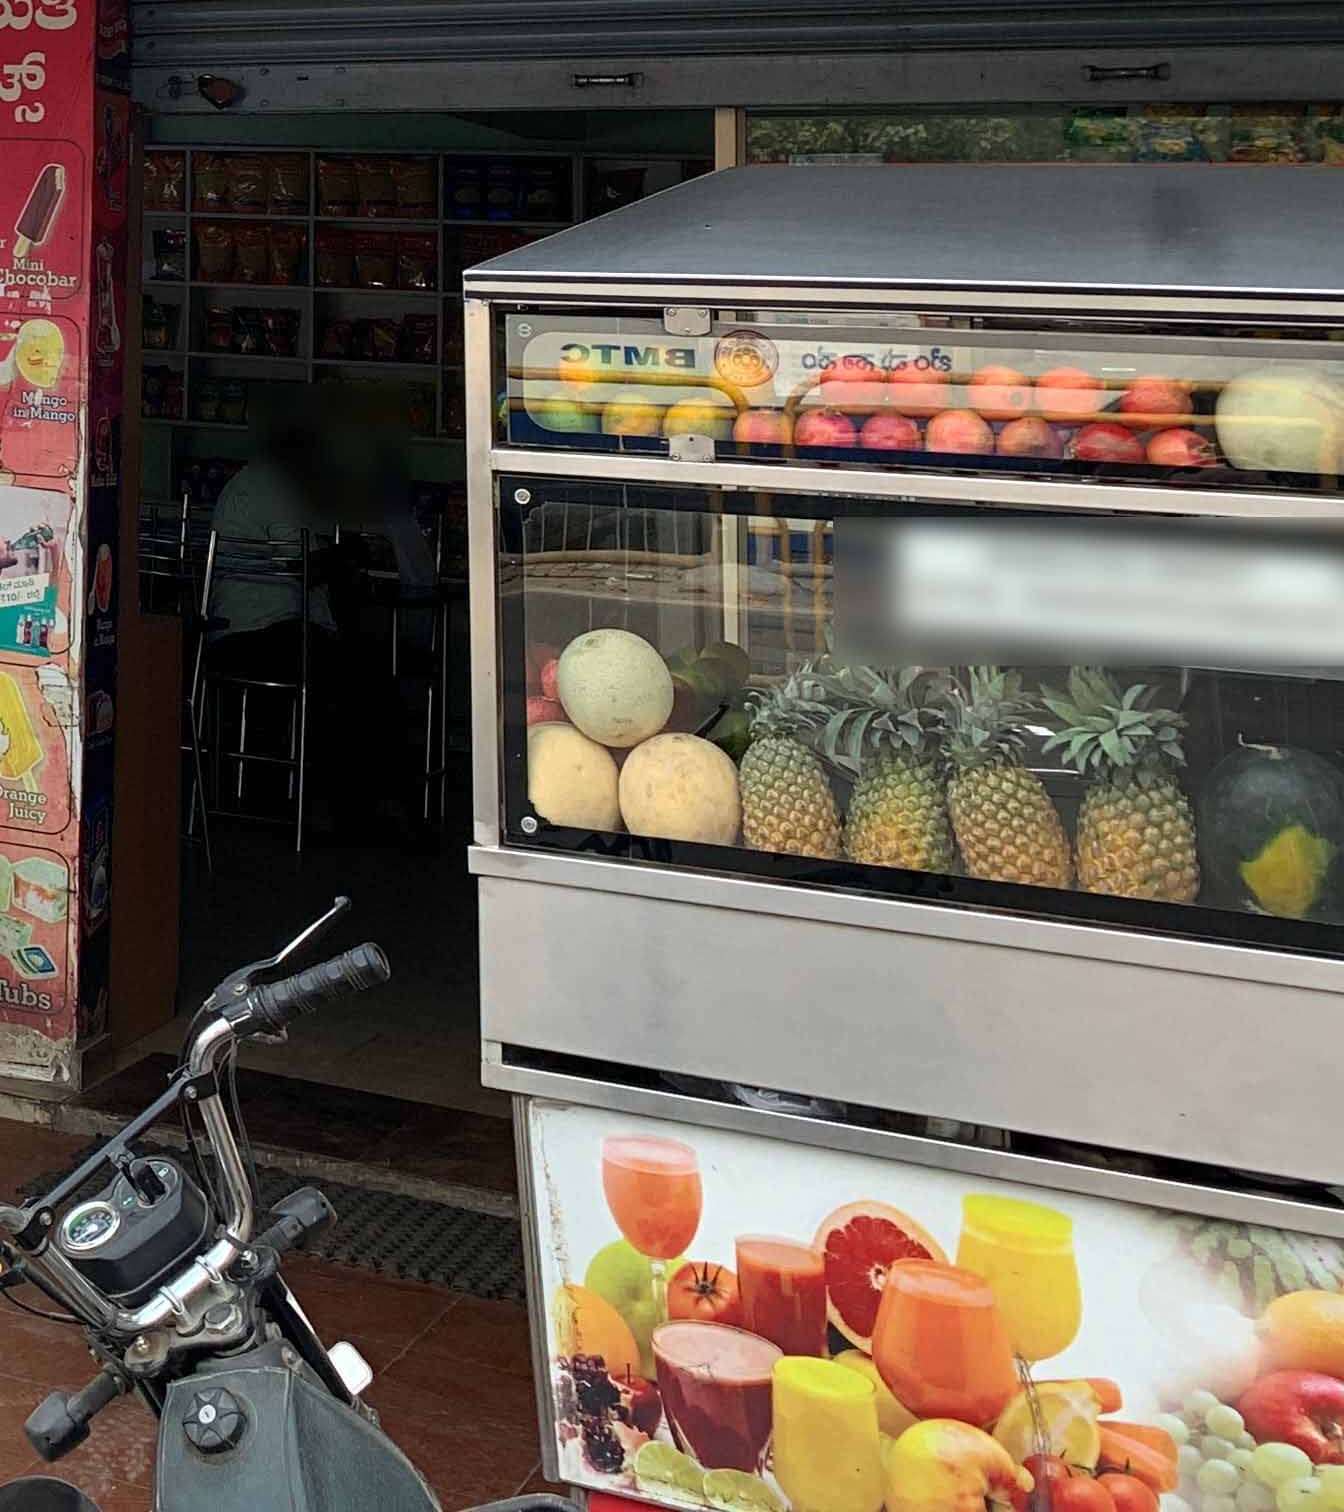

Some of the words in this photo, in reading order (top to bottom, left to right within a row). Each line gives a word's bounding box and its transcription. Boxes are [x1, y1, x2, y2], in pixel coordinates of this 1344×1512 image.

[13, 258, 45, 272] Mini
[22, 390, 67, 407] Mngo
[30, 407, 75, 424] Mango
[9, 803, 47, 824] Juicy
